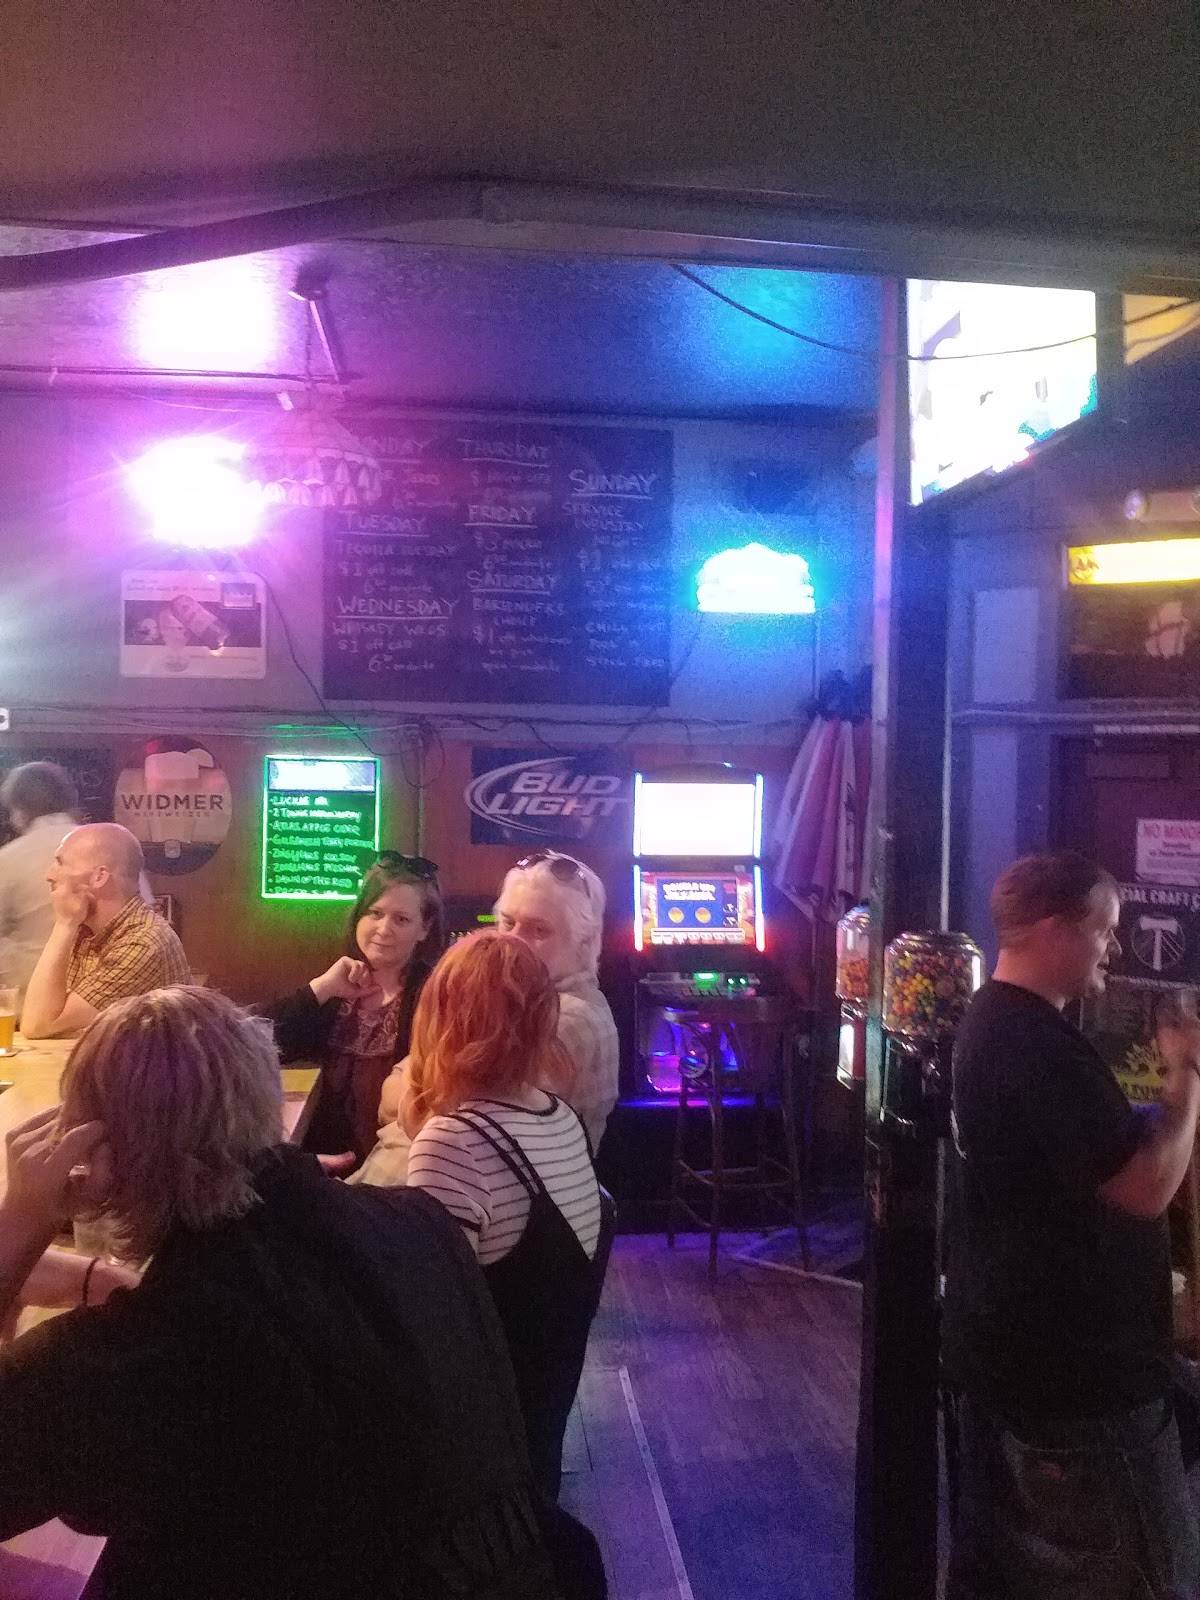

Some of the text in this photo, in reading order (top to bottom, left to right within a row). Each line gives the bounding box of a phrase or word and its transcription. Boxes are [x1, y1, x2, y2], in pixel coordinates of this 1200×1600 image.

[568, 469, 656, 494] SUNDAY
[338, 510, 426, 532] TUESDAY
[468, 504, 537, 523] FRIDAY
[466, 570, 559, 590] SATURDAY
[337, 596, 460, 617] WEDNESDAY
[510, 772, 623, 793] BUD
[121, 794, 224, 810] WIDMER
[485, 792, 632, 816] LIGHT
[1164, 824, 1200, 841] MINO
